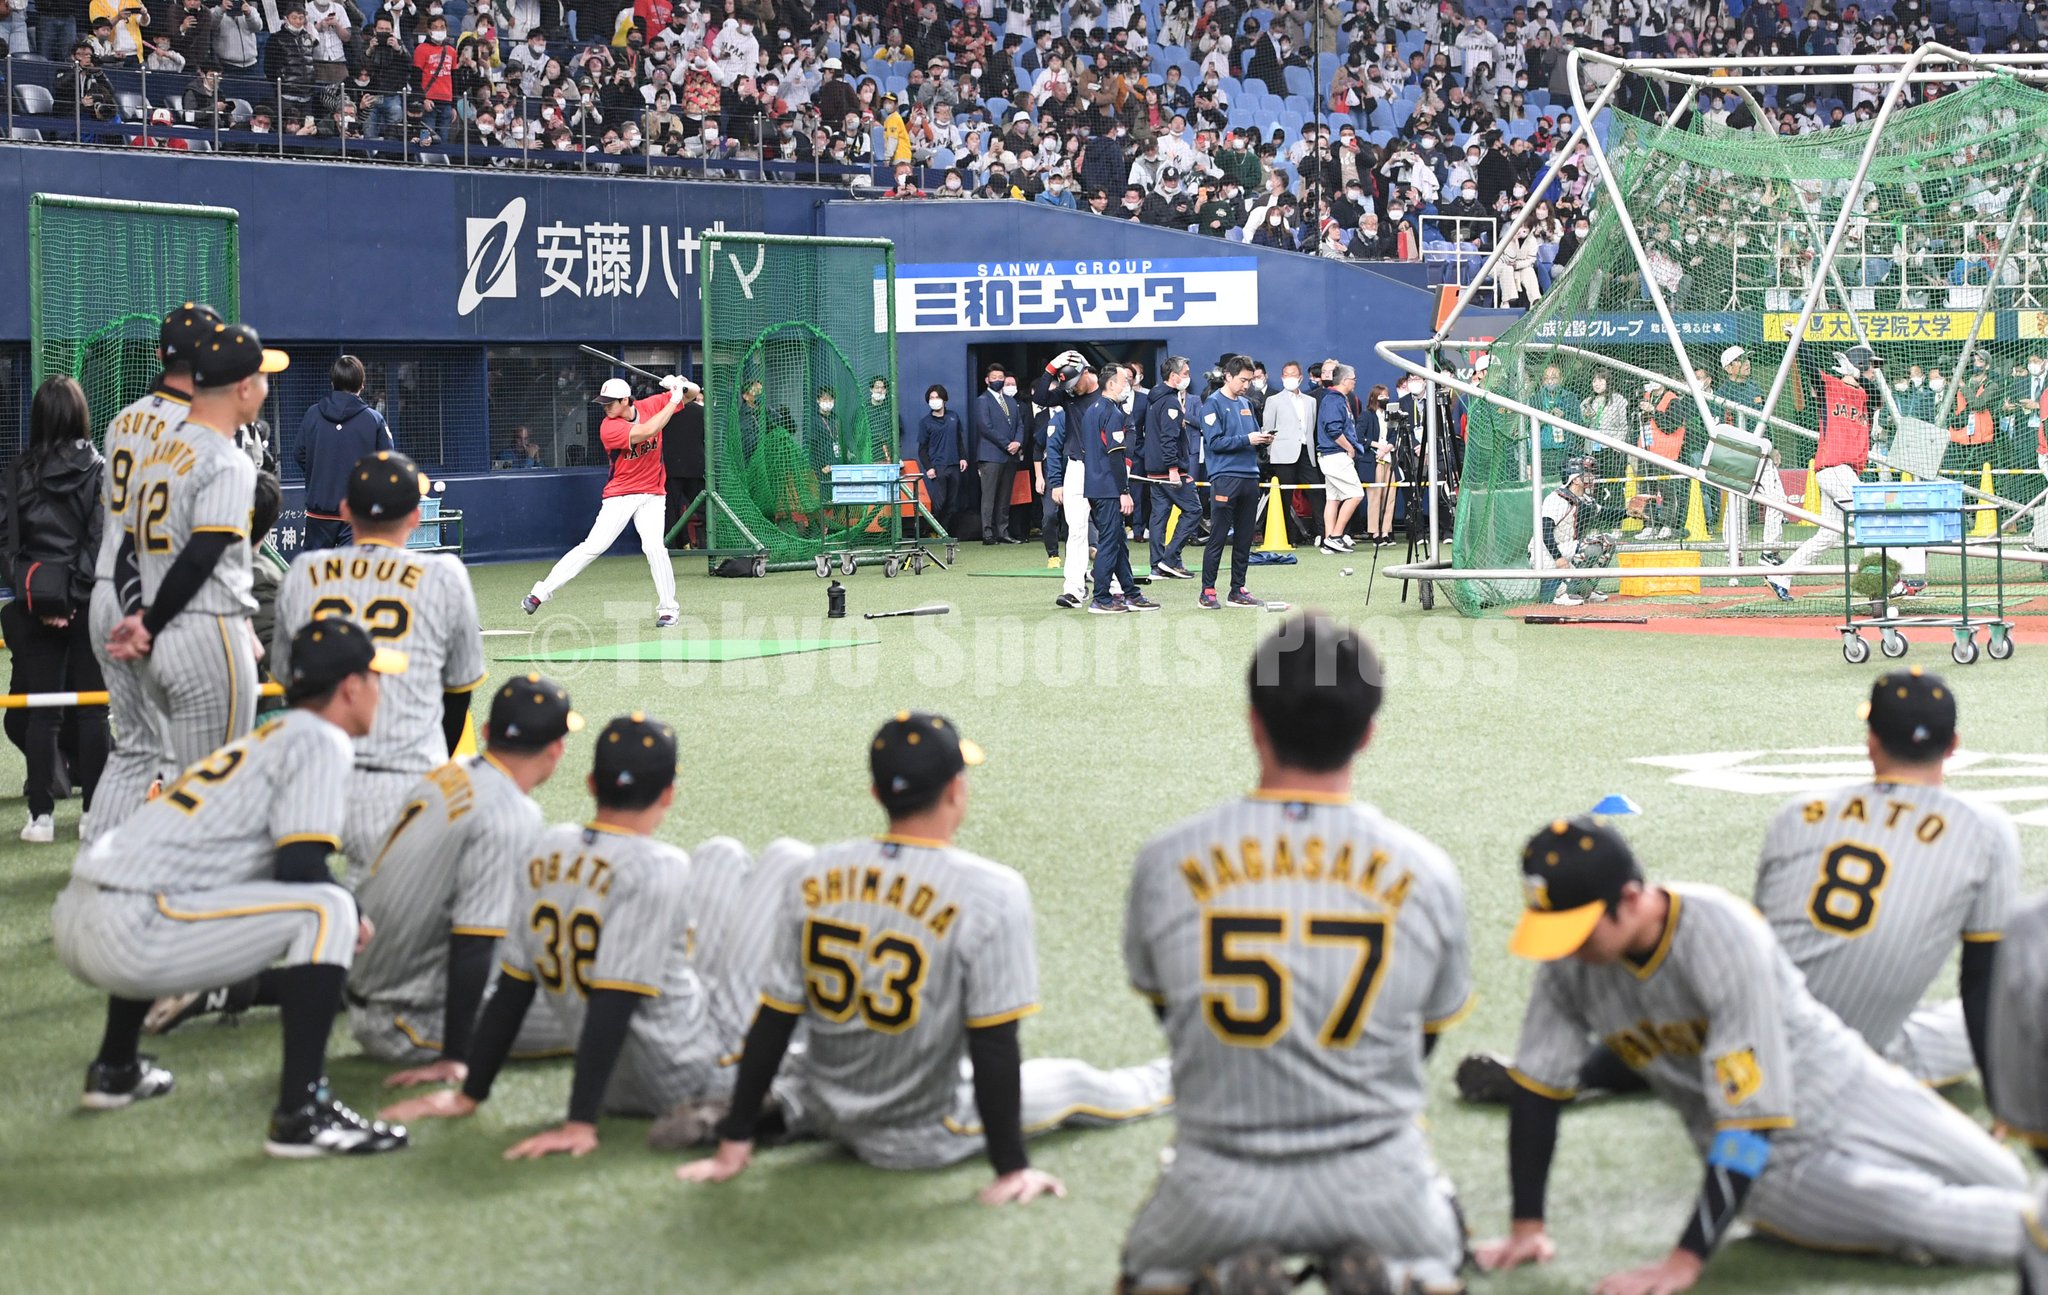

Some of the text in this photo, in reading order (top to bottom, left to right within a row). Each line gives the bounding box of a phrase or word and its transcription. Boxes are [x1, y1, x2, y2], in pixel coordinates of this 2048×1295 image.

[914, 277, 1217, 327] 三和シャッター
[977, 260, 1154, 277] SANWA GROUP
[114, 411, 166, 441] TSUTS
[111, 447, 137, 515] 9
[135, 480, 174, 553] 12
[309, 558, 425, 590] INOUE
[1802, 795, 1946, 844] SATO
[801, 864, 960, 941] SHIMADA
[1178, 832, 1416, 908] NAGASAKA
[1806, 838, 1892, 940] 8
[531, 899, 603, 998] 38
[801, 915, 931, 1036] 53
[1203, 908, 1394, 1050] 57
